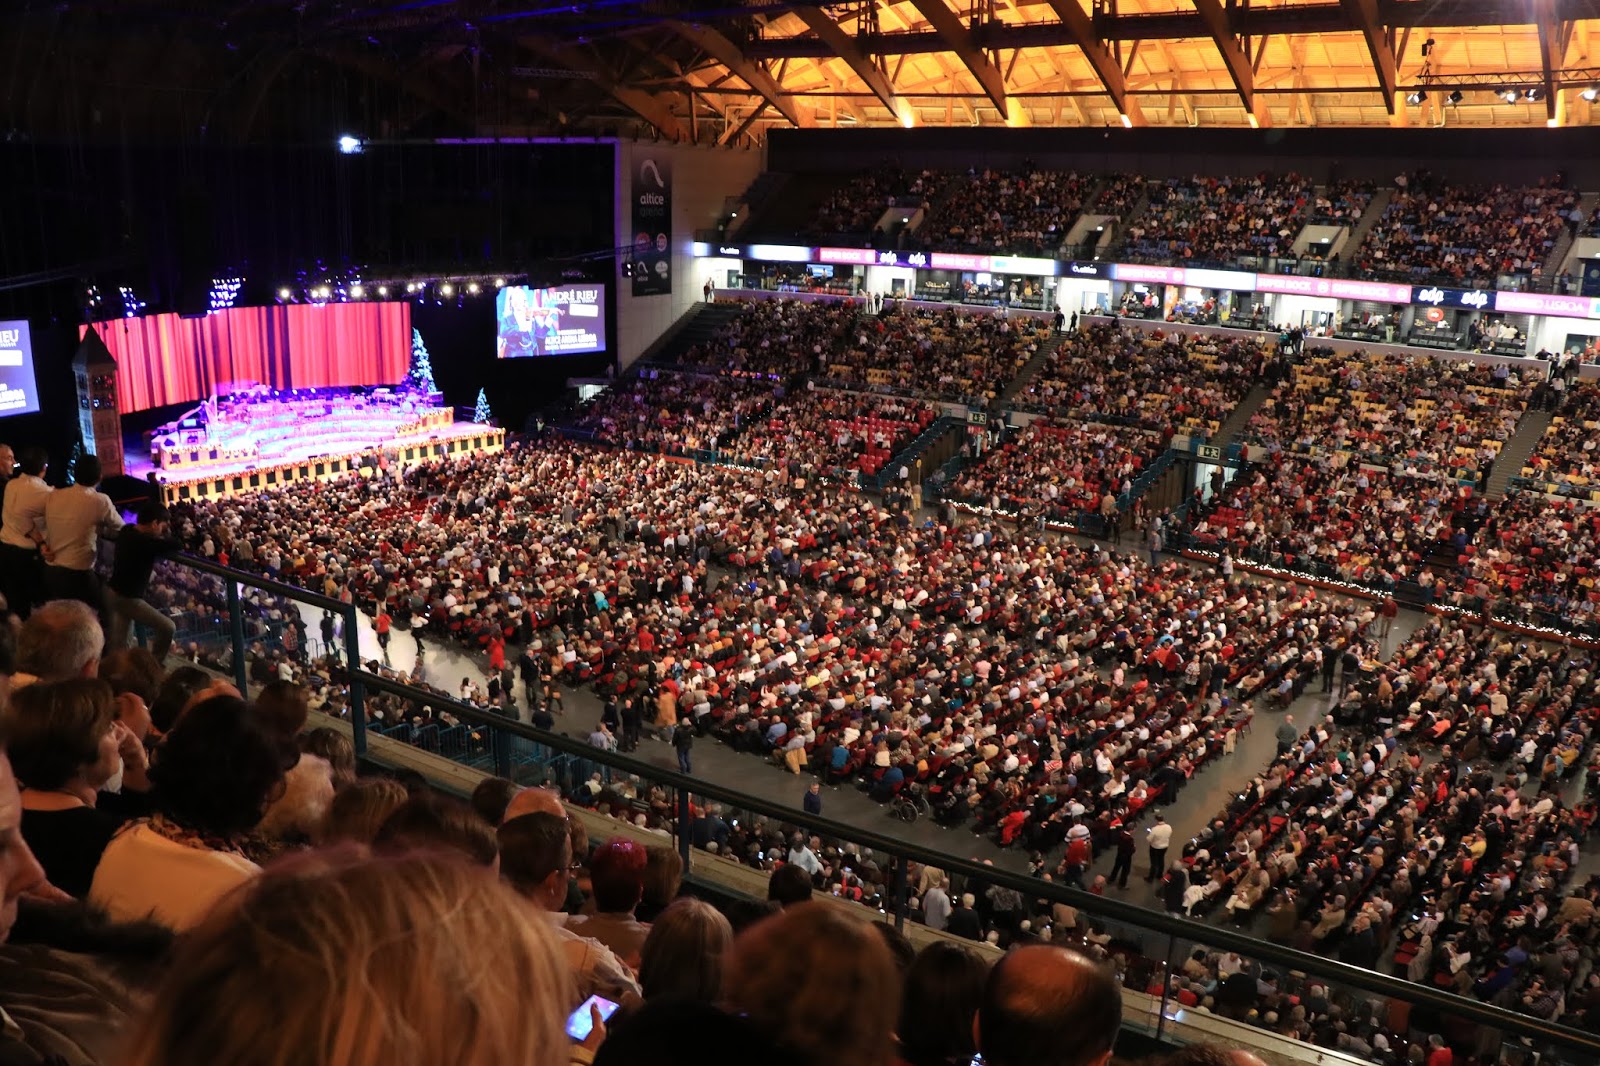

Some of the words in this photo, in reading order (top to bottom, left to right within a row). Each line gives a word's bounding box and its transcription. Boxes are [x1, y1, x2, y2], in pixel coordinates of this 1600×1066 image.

[640, 192, 664, 205] altice
[576, 290, 598, 300] RIEU
[1418, 286, 1444, 306] edp
[1461, 290, 1488, 309] edp
[1545, 300, 1583, 312] LISBOA
